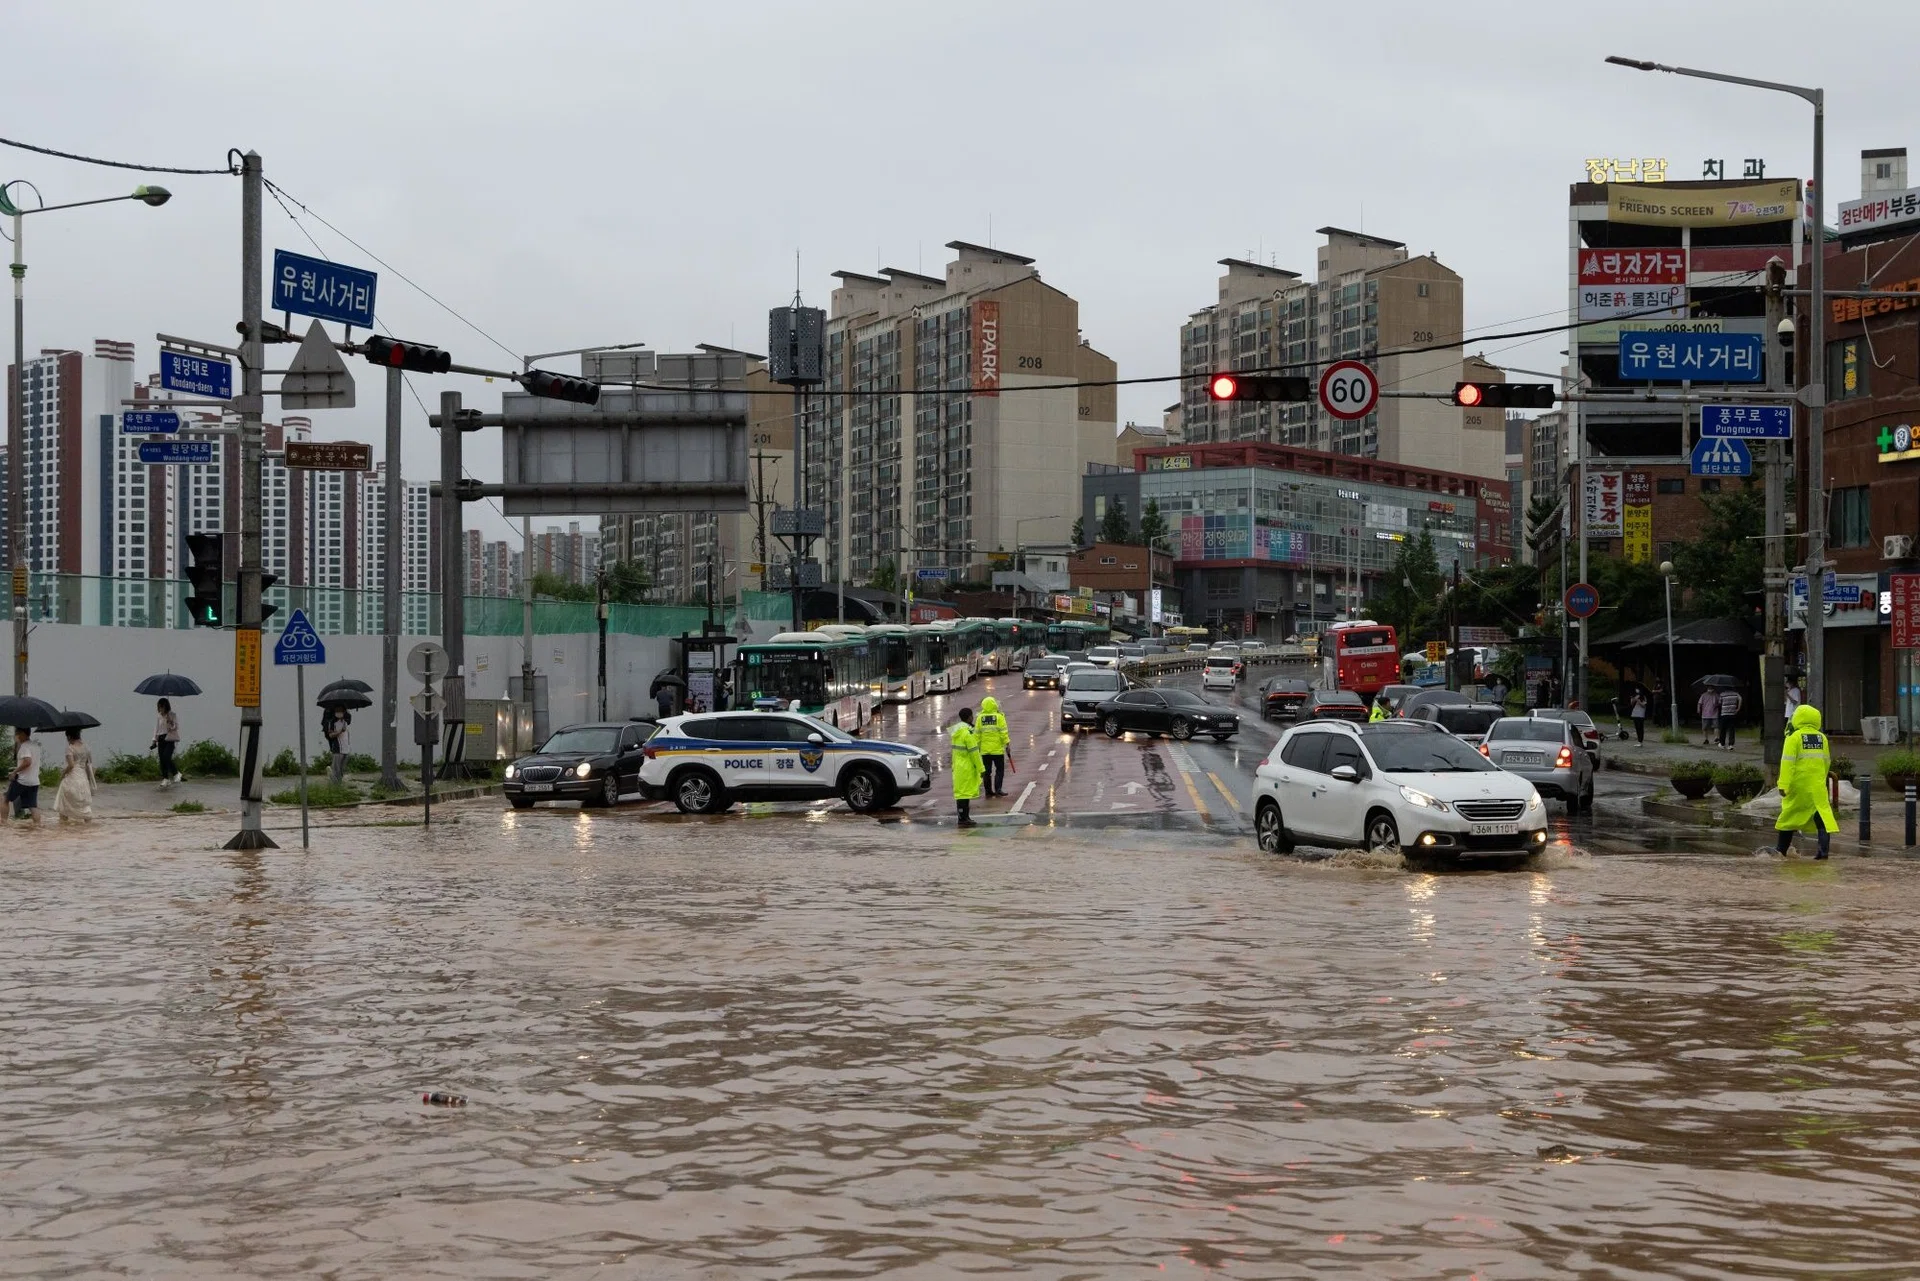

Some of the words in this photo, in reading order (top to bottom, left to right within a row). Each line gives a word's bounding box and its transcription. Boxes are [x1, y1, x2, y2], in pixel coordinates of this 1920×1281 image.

[1586, 158, 1668, 184] 장난감
[1780, 187, 1792, 196] 5F
[1619, 202, 1666, 215] FRIENDS
[1671, 207, 1714, 216] SCREEN
[1841, 194, 1920, 226] 검단메카부동
[1603, 252, 1683, 275] 라자가구
[280, 265, 370, 315] 유현사거리
[1413, 331, 1434, 342] 209
[982, 319, 996, 381] IPARK
[1629, 342, 1753, 370] 유현사거리
[173, 356, 209, 377] 원당대로
[1018, 356, 1042, 369] 208
[170, 376, 213, 394] Wondang-daero
[1332, 378, 1366, 403] 60
[1719, 408, 1761, 424] 풍무로
[1774, 409, 1787, 417] 242
[1466, 416, 1482, 425] 205
[1715, 424, 1765, 435] Pungmu-ro
[1778, 427, 1783, 435] 2
[171, 443, 209, 454] 원당대로
[1701, 464, 1742, 474] 횡단보도
[749, 655, 760, 664] 81
[751, 691, 761, 699] 81
[724, 759, 763, 769] POLICE
[775, 758, 794, 769] 경찰
